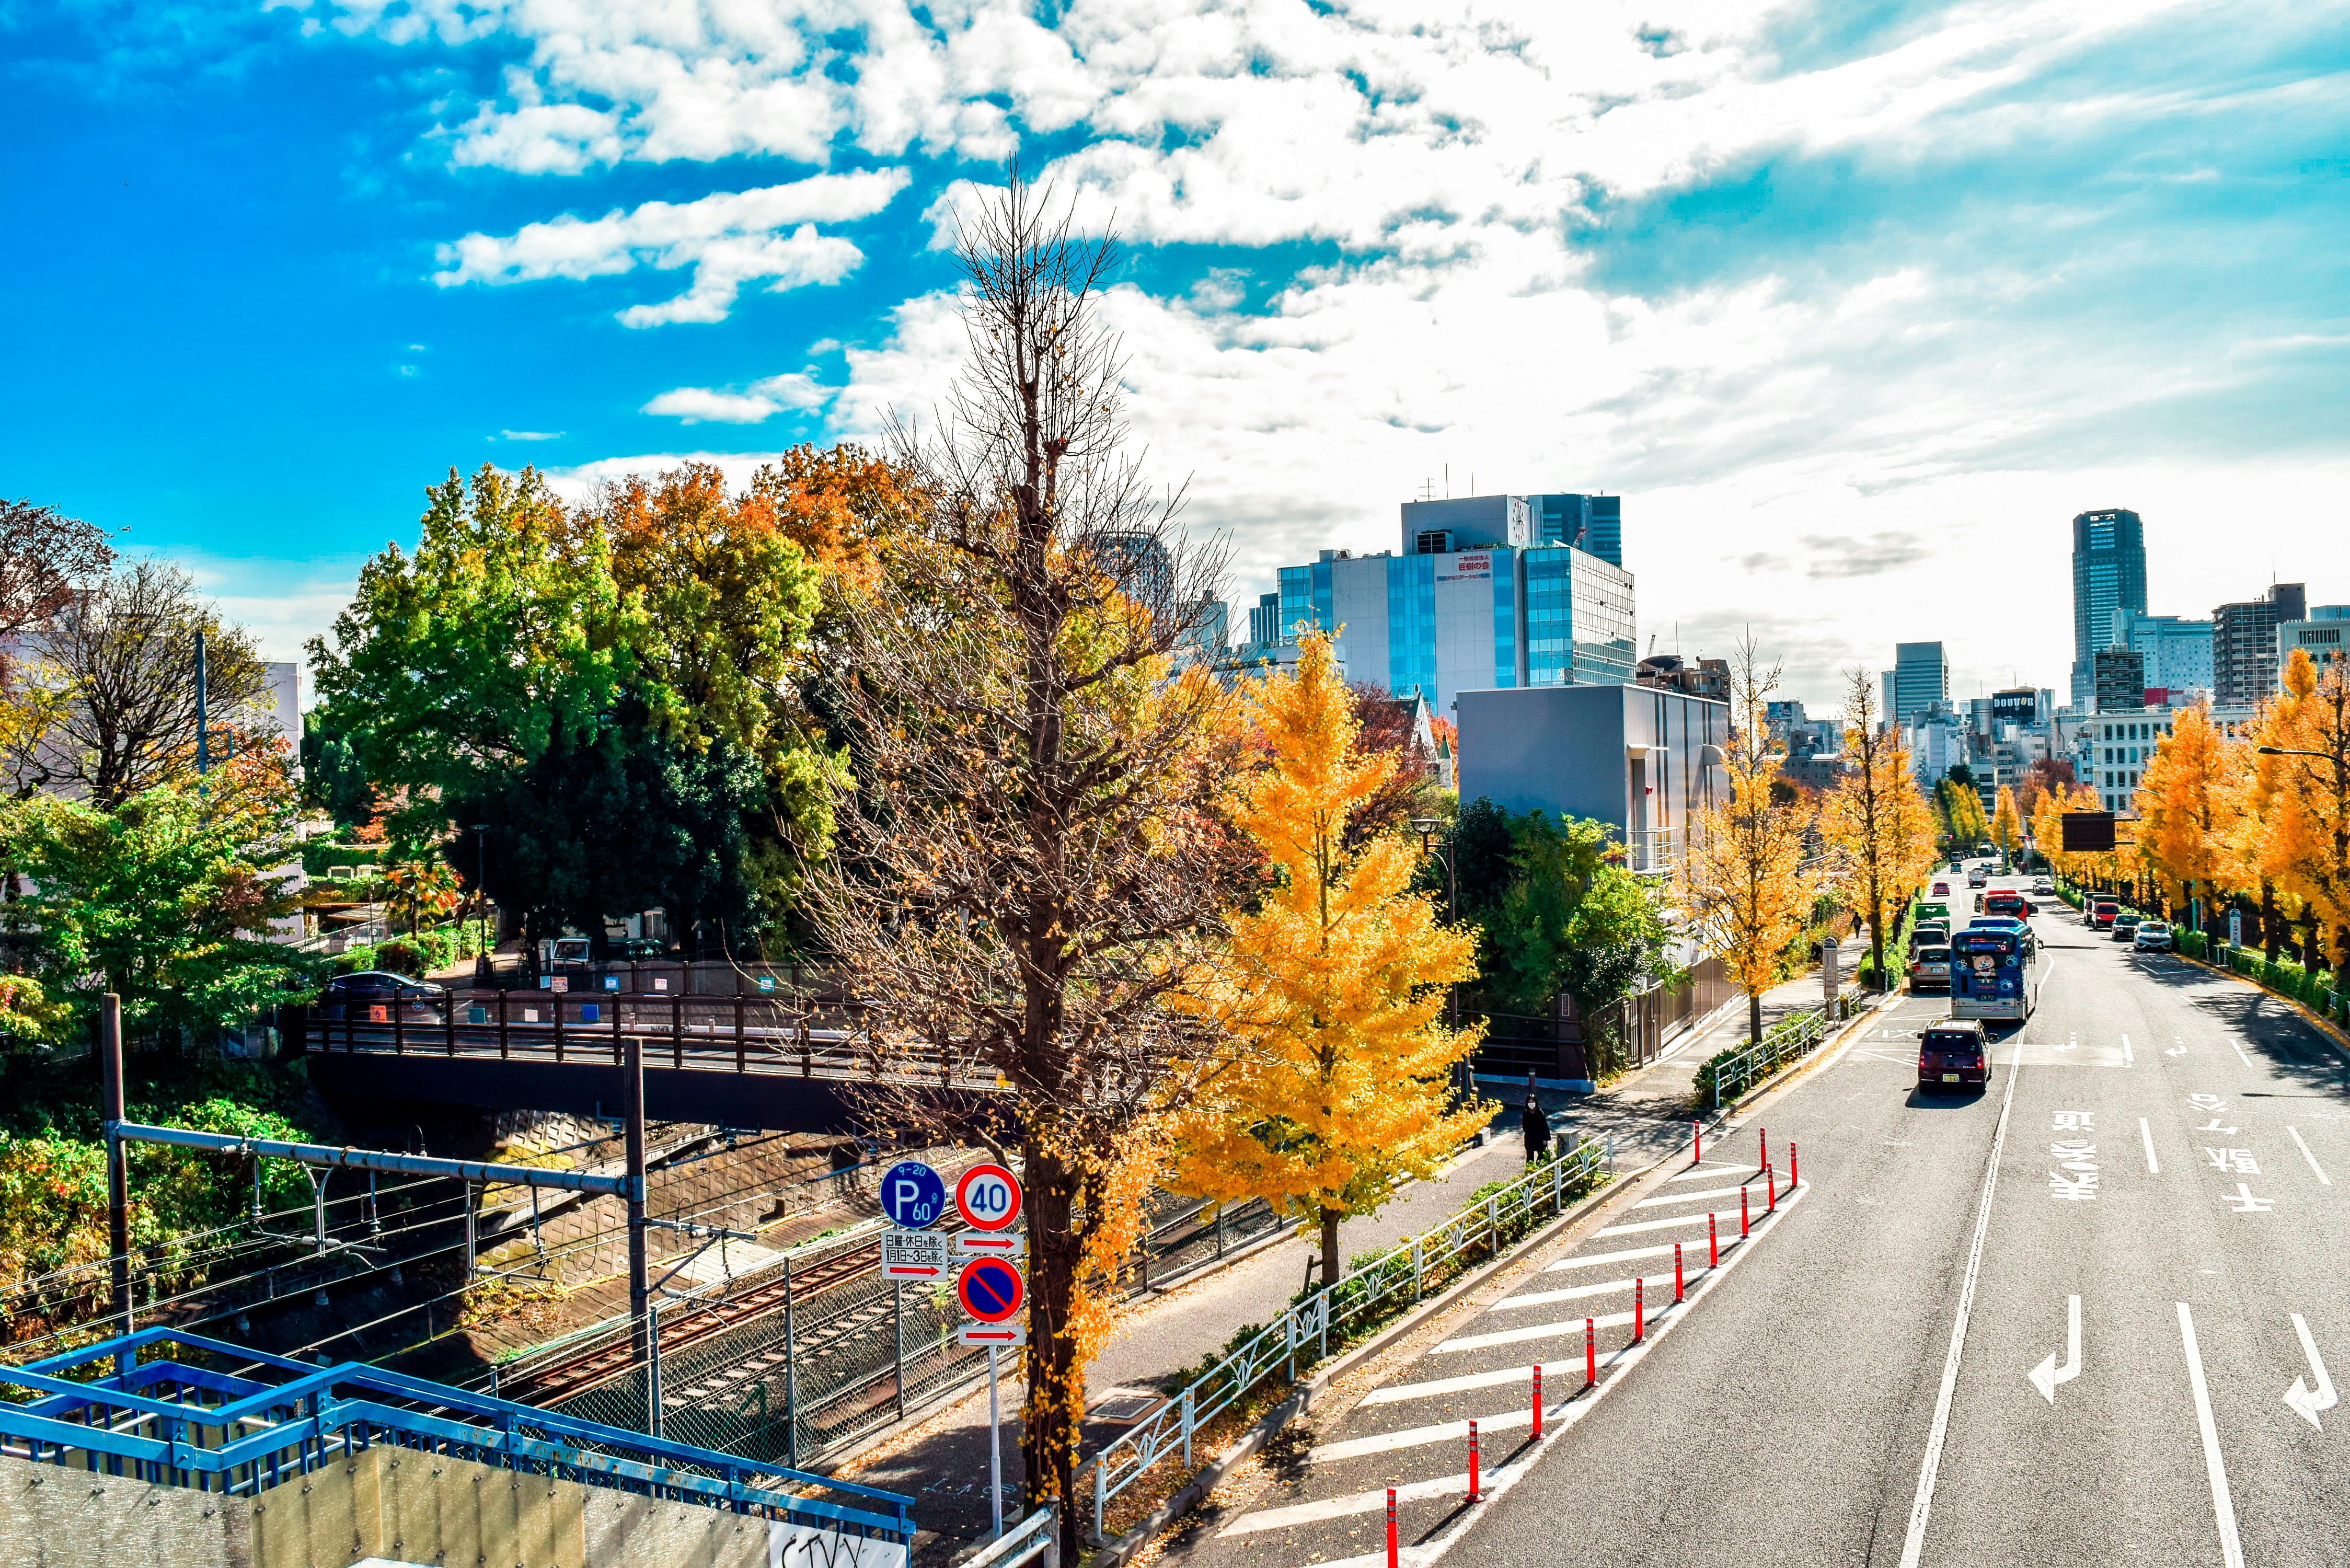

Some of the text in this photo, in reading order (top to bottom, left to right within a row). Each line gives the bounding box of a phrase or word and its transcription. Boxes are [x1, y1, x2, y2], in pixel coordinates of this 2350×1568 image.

[1458, 561, 1489, 571] 巨樹の会
[1994, 697, 2034, 707] DOUTOR
[898, 1165, 926, 1177] 9-20
[895, 1180, 919, 1220] P
[971, 1183, 1006, 1213] 40
[913, 1203, 930, 1221] 60
[886, 1235, 942, 1248] 日曜・休日を除く
